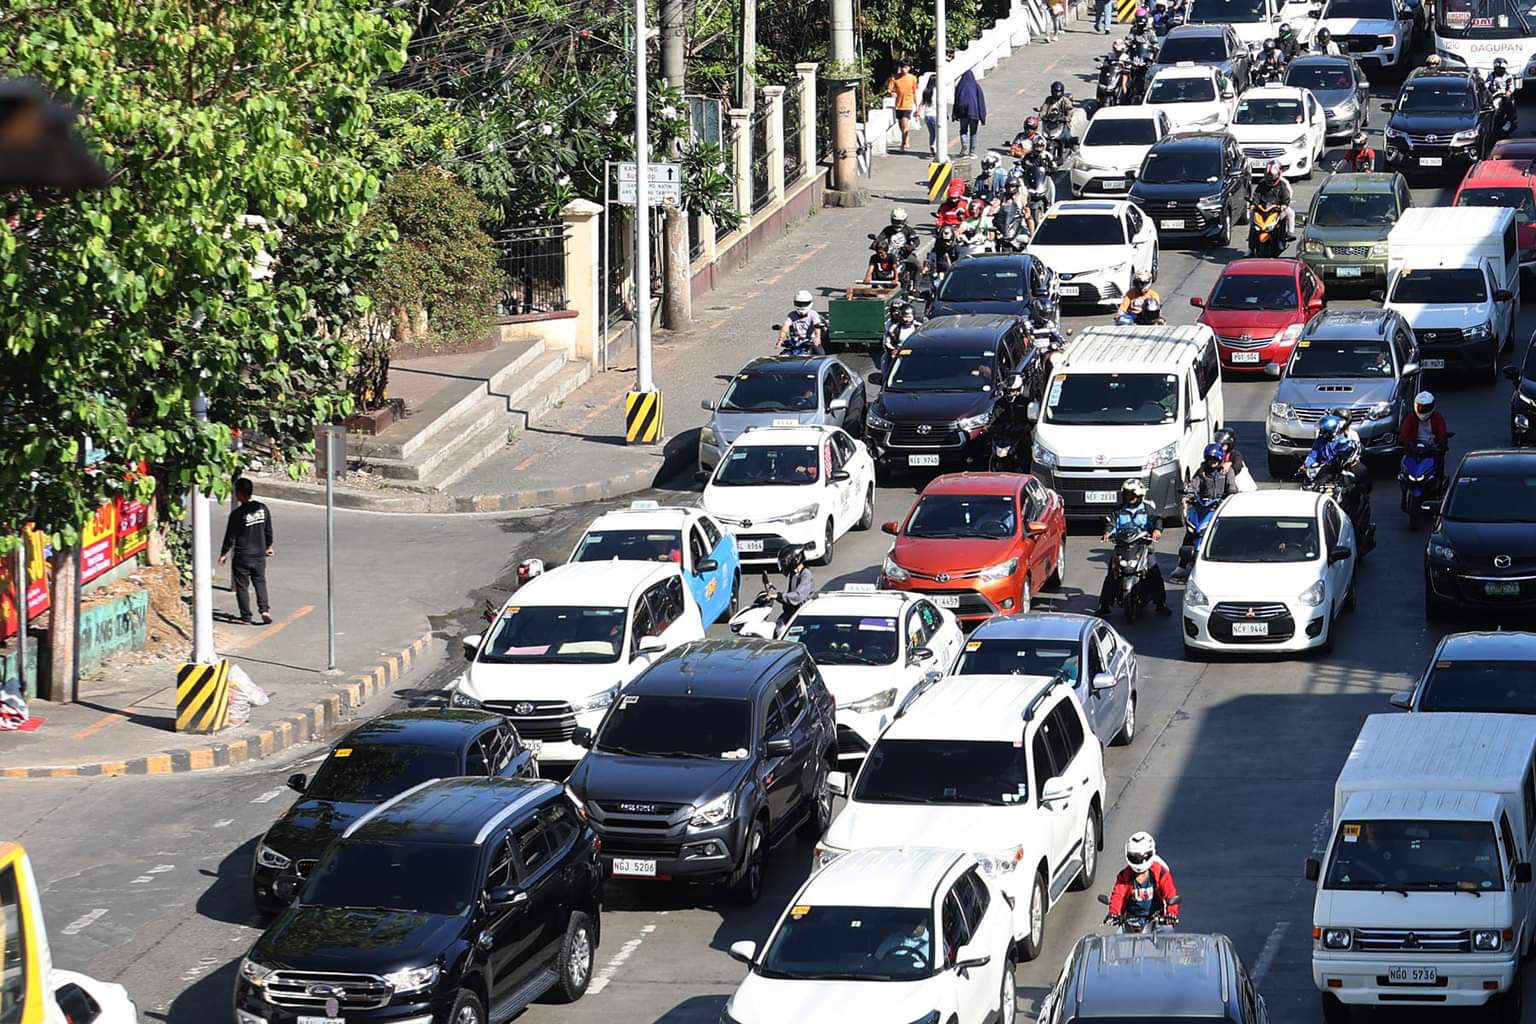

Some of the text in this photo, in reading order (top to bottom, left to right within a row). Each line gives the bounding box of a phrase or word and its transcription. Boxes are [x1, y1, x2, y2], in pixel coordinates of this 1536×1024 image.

[1470, 43, 1523, 53] DAGUPAN
[614, 860, 655, 873] NGJ 5206
[1412, 969, 1436, 982] 5736
